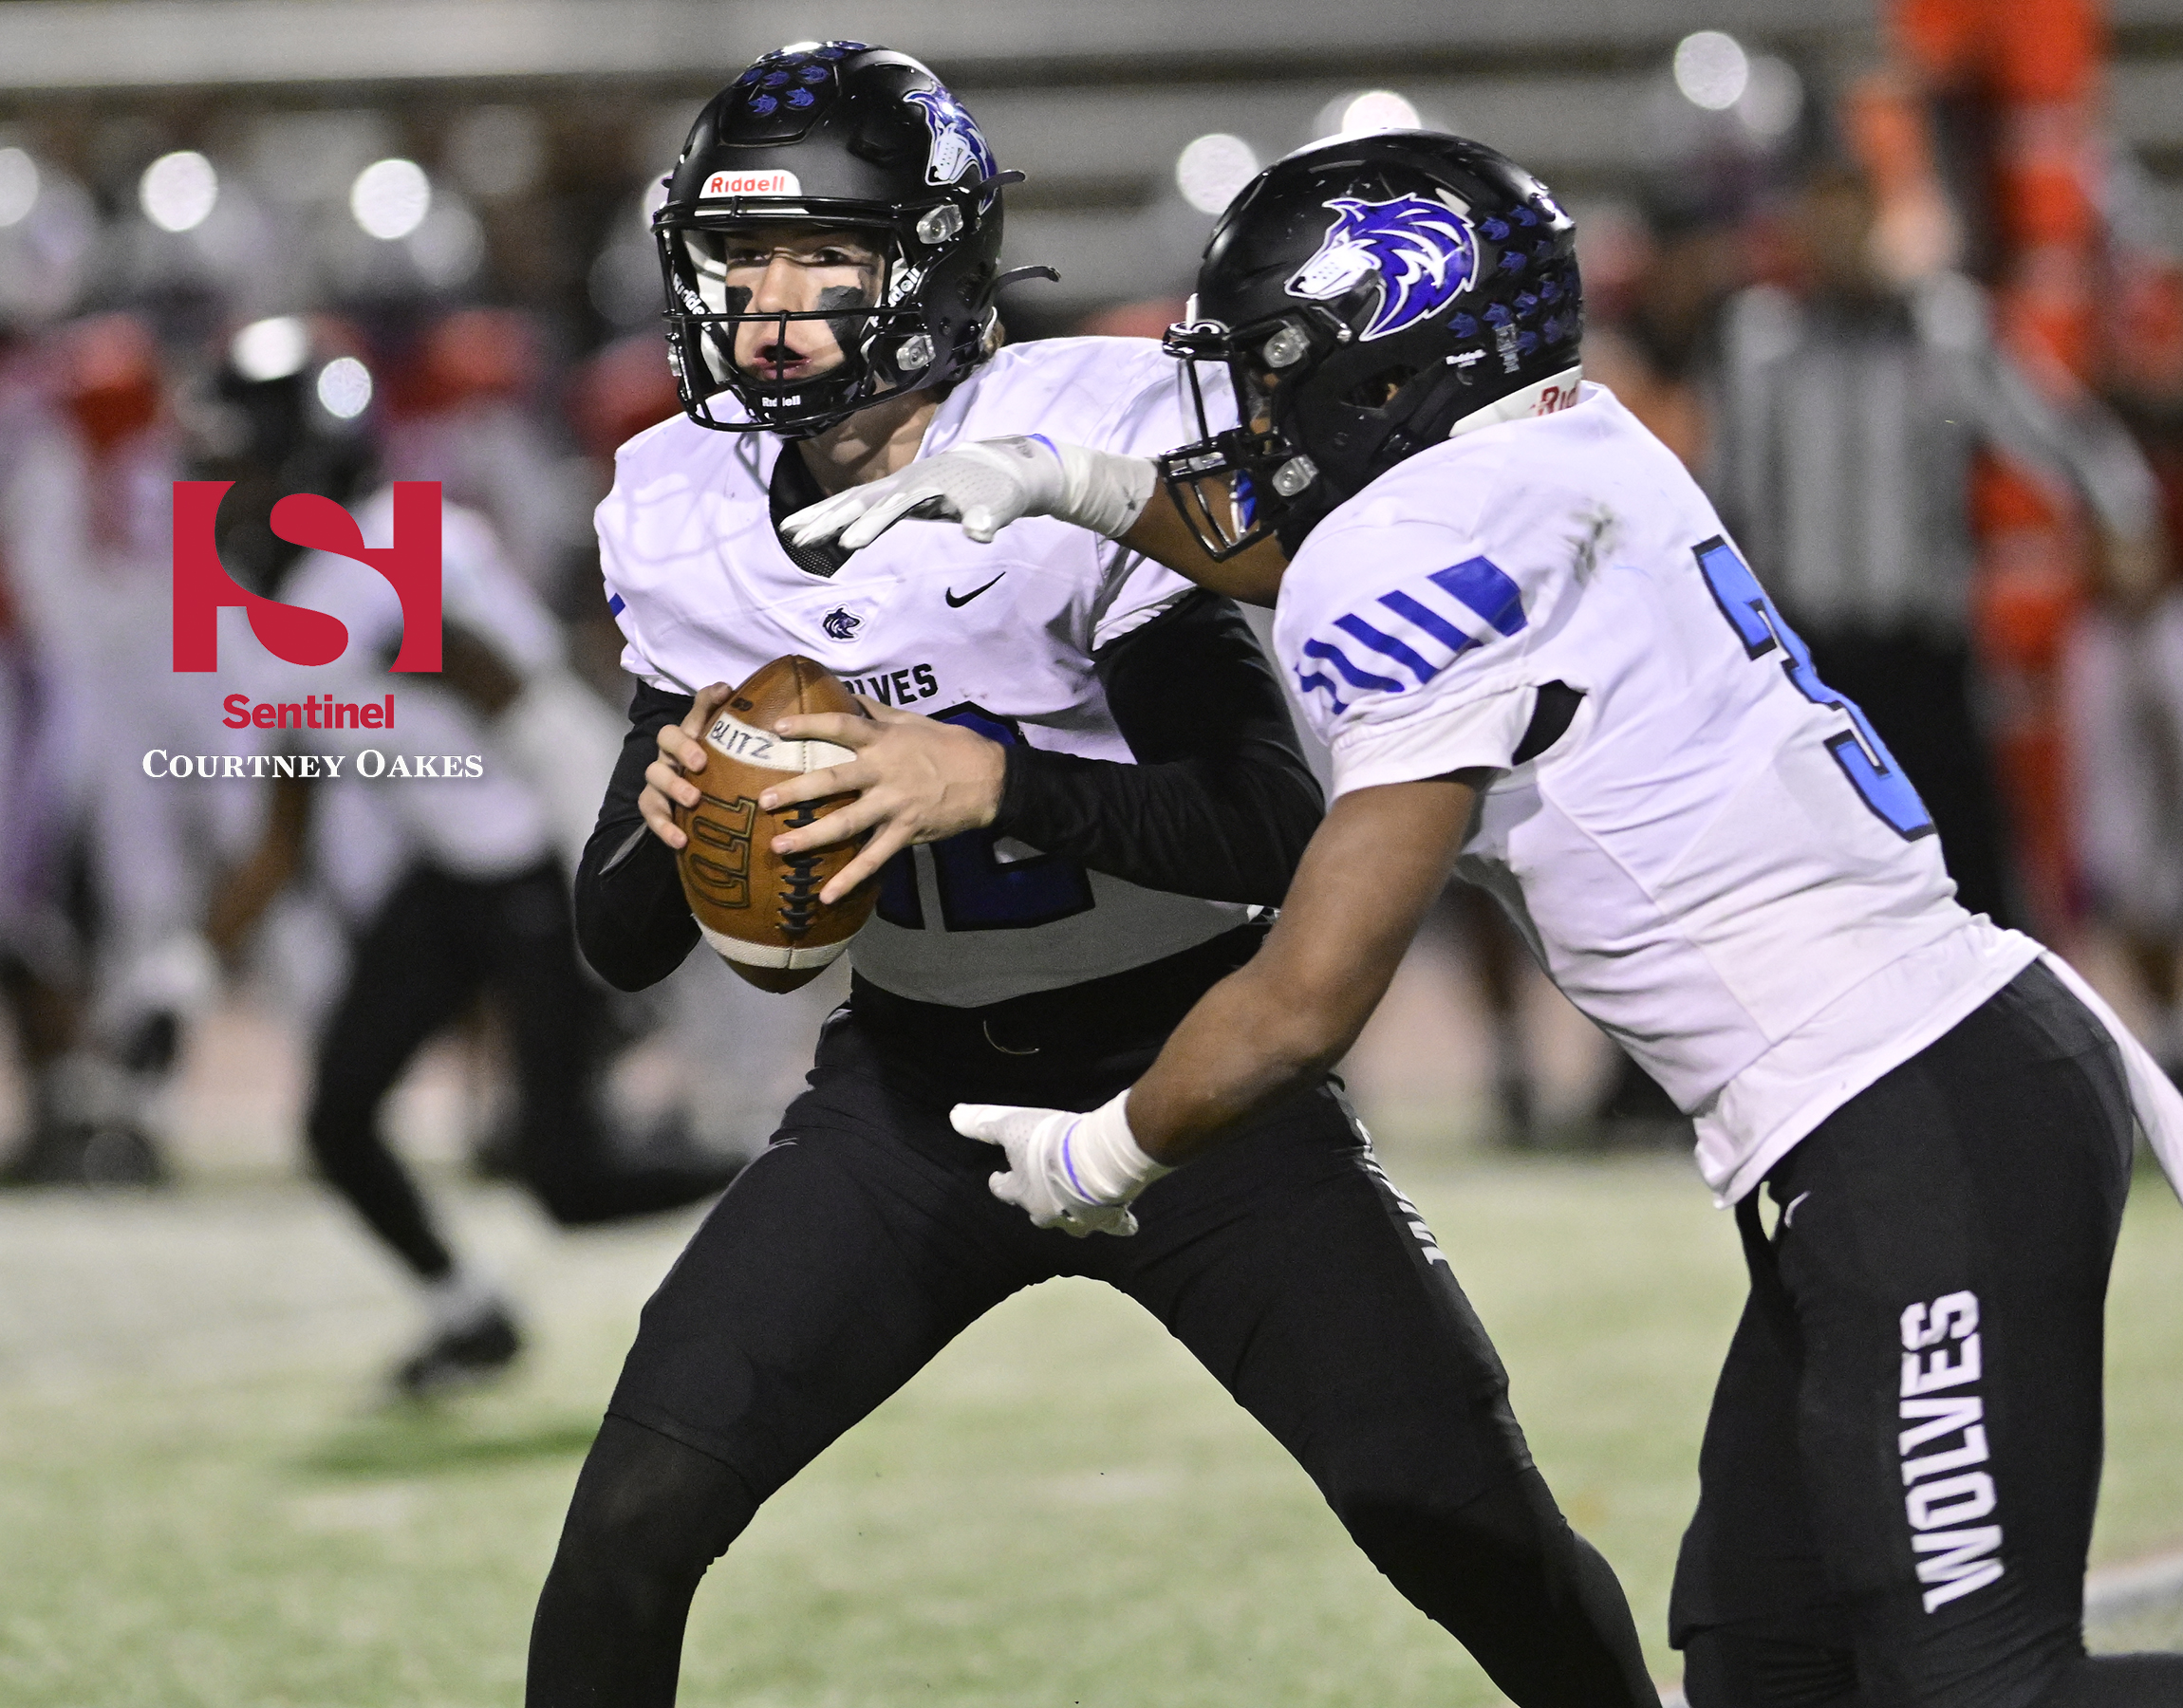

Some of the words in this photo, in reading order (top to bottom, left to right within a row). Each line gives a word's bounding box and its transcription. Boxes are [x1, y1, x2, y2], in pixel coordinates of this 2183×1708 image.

[710, 176, 785, 194] Riddell
[711, 720, 774, 759] BLITZ
[1899, 1290, 2005, 1614] WOLVES
